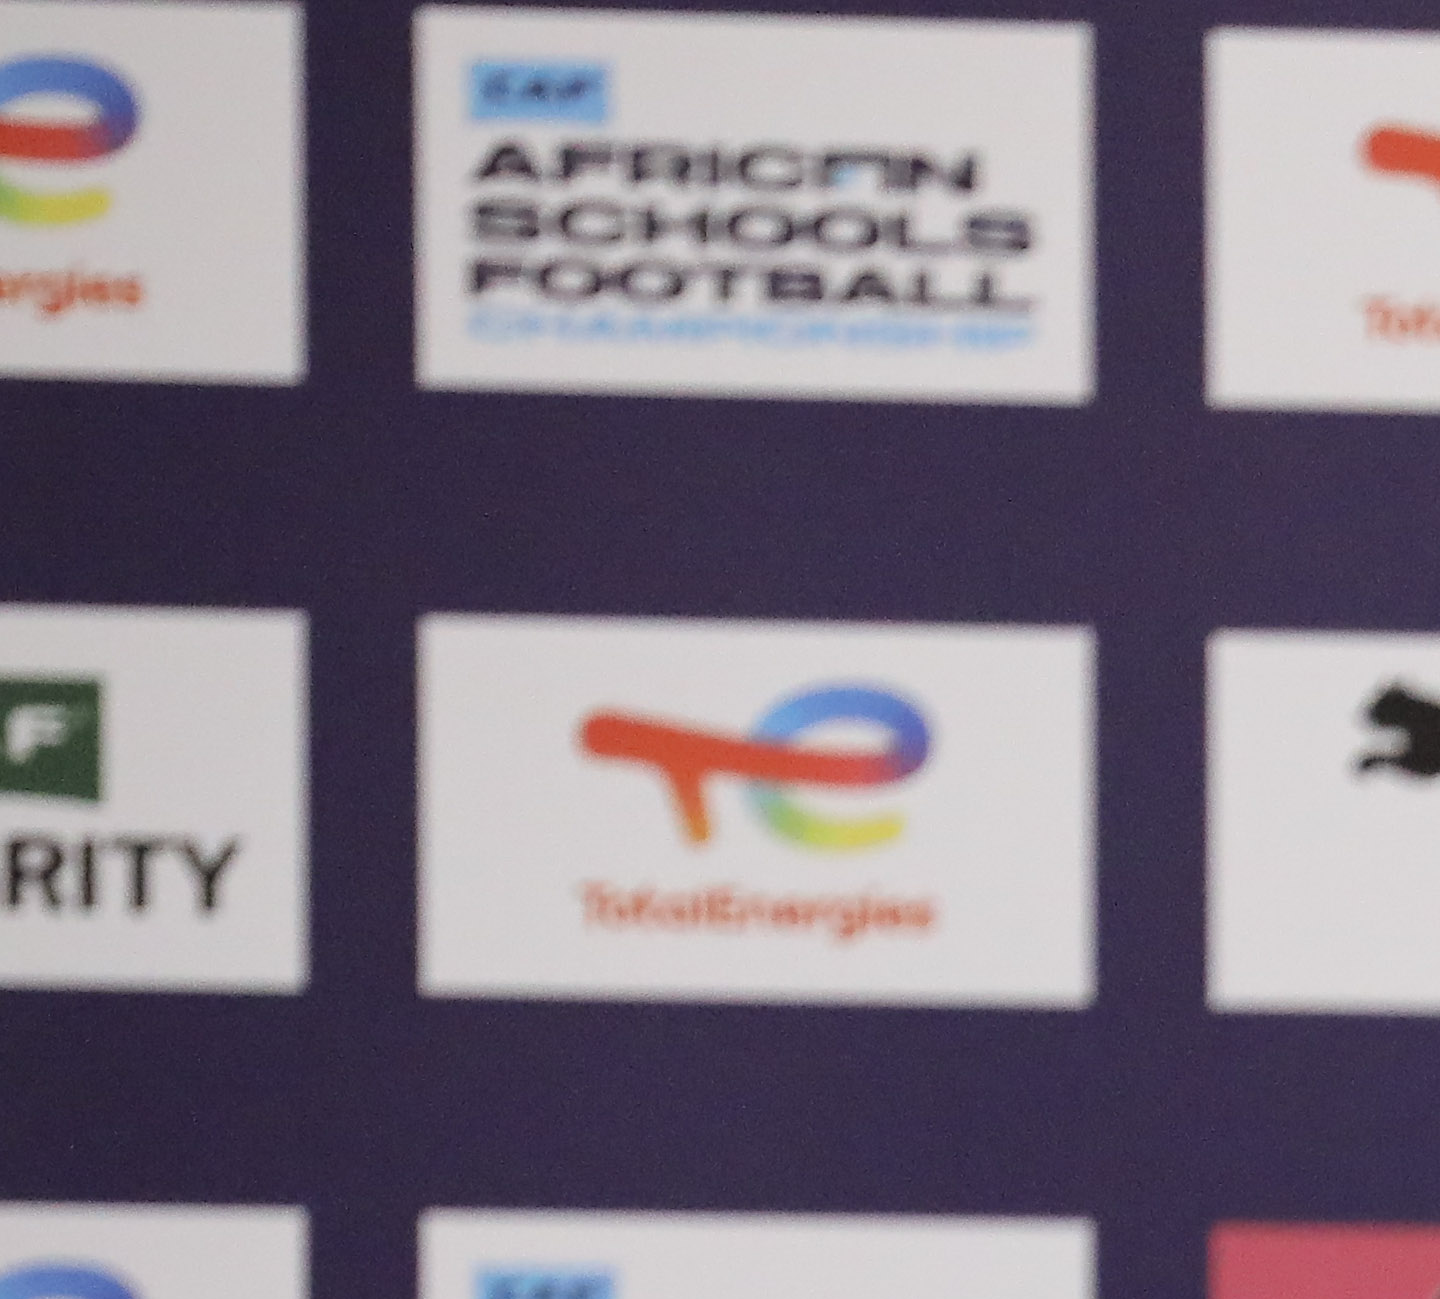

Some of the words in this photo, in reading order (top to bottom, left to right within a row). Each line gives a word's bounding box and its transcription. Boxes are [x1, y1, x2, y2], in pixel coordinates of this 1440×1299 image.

[471, 139, 980, 194] AFRICAN
[468, 202, 1034, 255] SCHOOLS
[466, 261, 1037, 313] FOOTBALL
